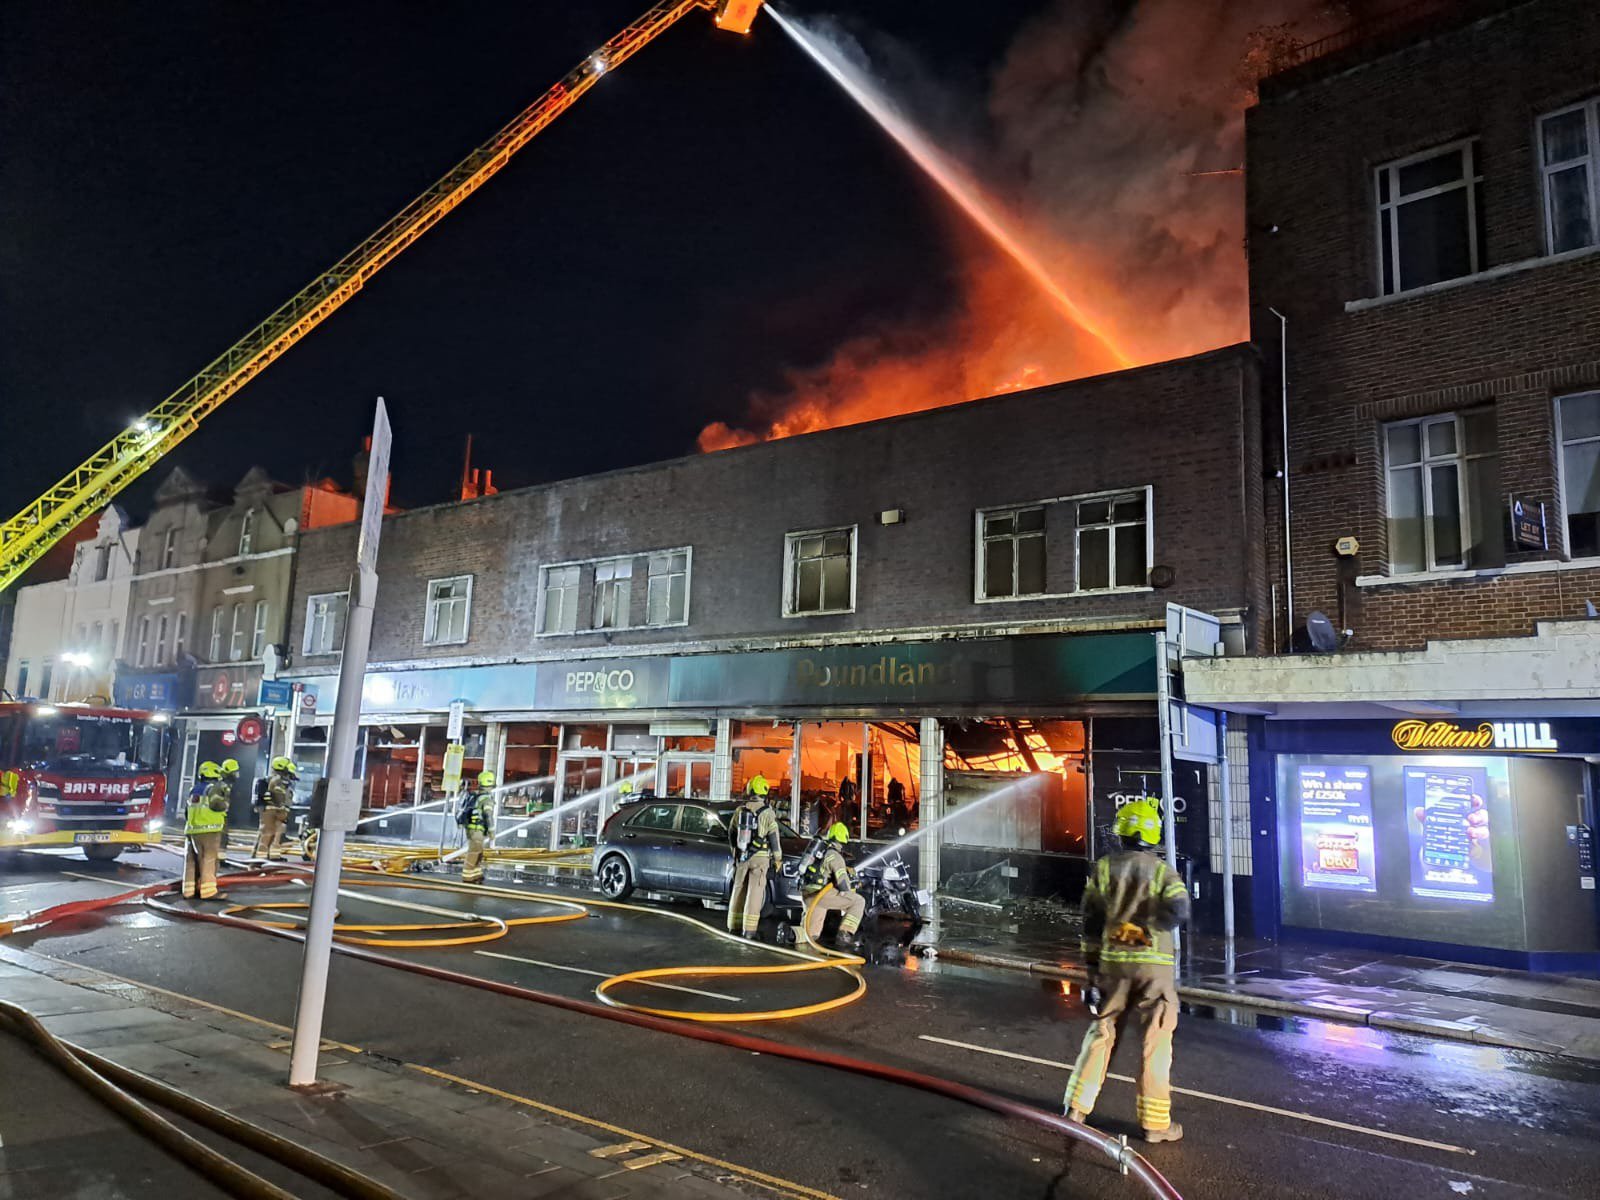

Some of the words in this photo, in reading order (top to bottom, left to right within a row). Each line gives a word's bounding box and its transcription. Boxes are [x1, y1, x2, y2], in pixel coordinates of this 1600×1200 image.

[797, 656, 956, 688] Poundlan
[1392, 719, 1495, 751] William
[1494, 722, 1558, 749] HILL
[99, 783, 130, 794] FIRE
[1302, 780, 1323, 789] Win
[1333, 781, 1362, 790] share
[1302, 790, 1315, 799] of
